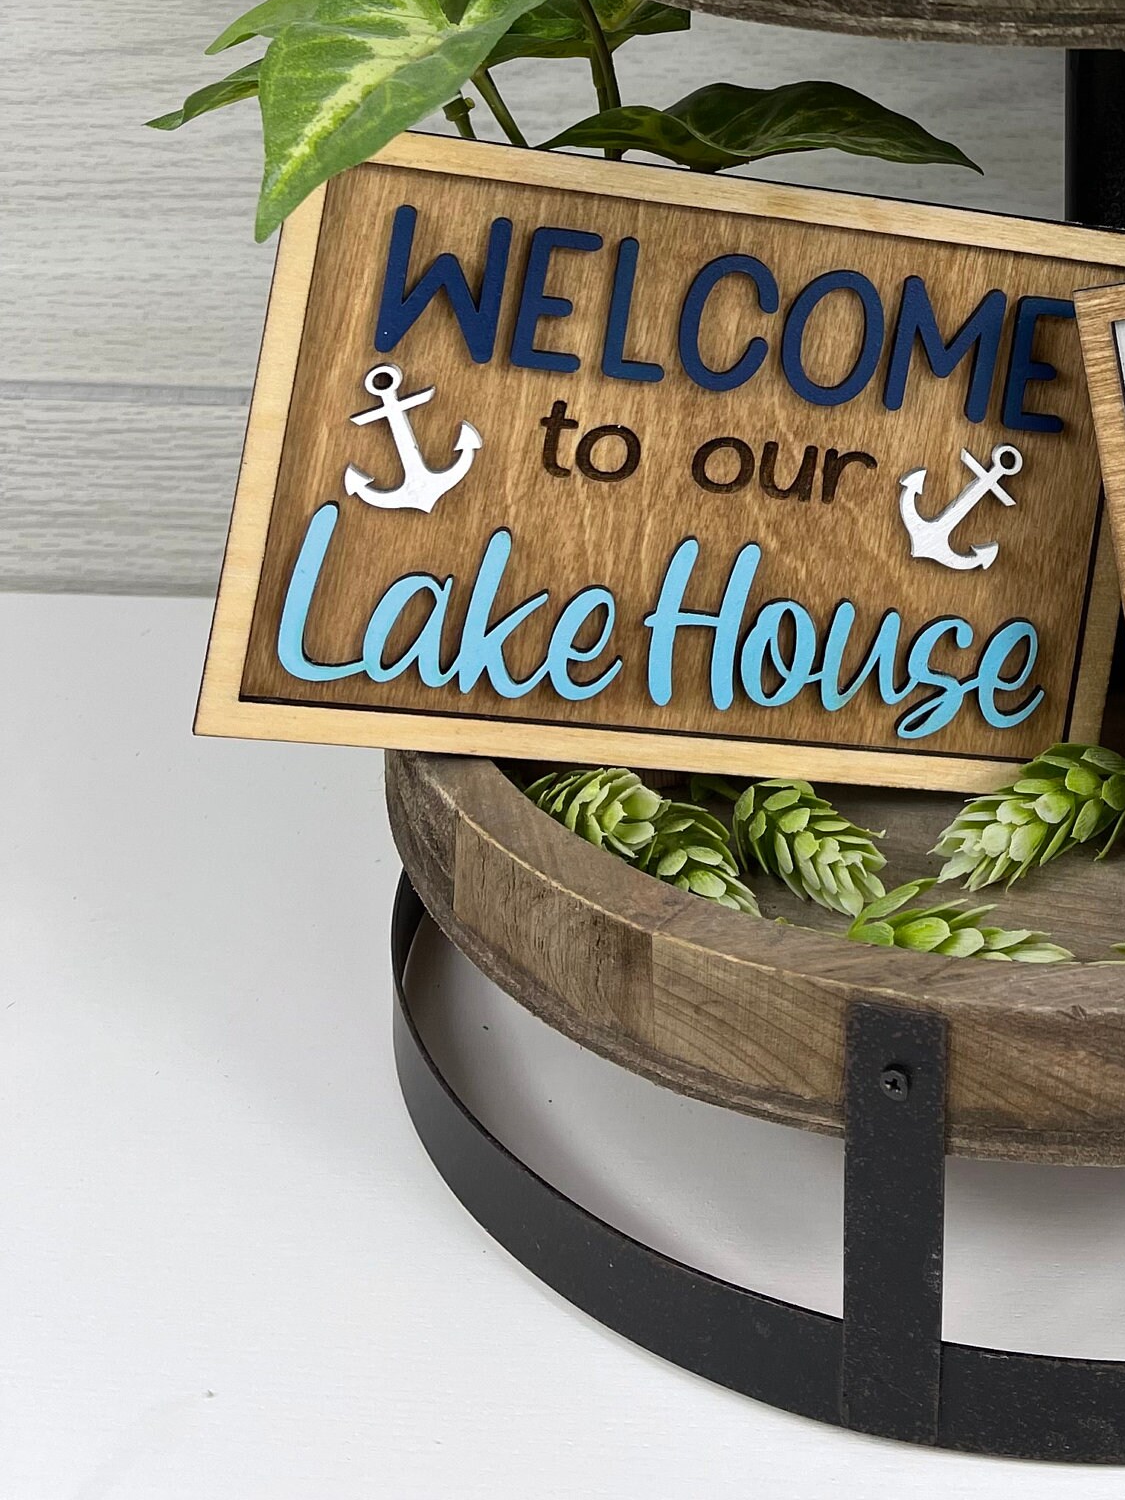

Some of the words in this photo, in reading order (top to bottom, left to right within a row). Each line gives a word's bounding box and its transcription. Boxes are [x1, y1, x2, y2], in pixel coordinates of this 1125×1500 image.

[372, 204, 1076, 434] WELCOME
[540, 399, 642, 482] to
[691, 435, 877, 504] our
[277, 501, 624, 700] Lake
[644, 536, 1044, 741] House
